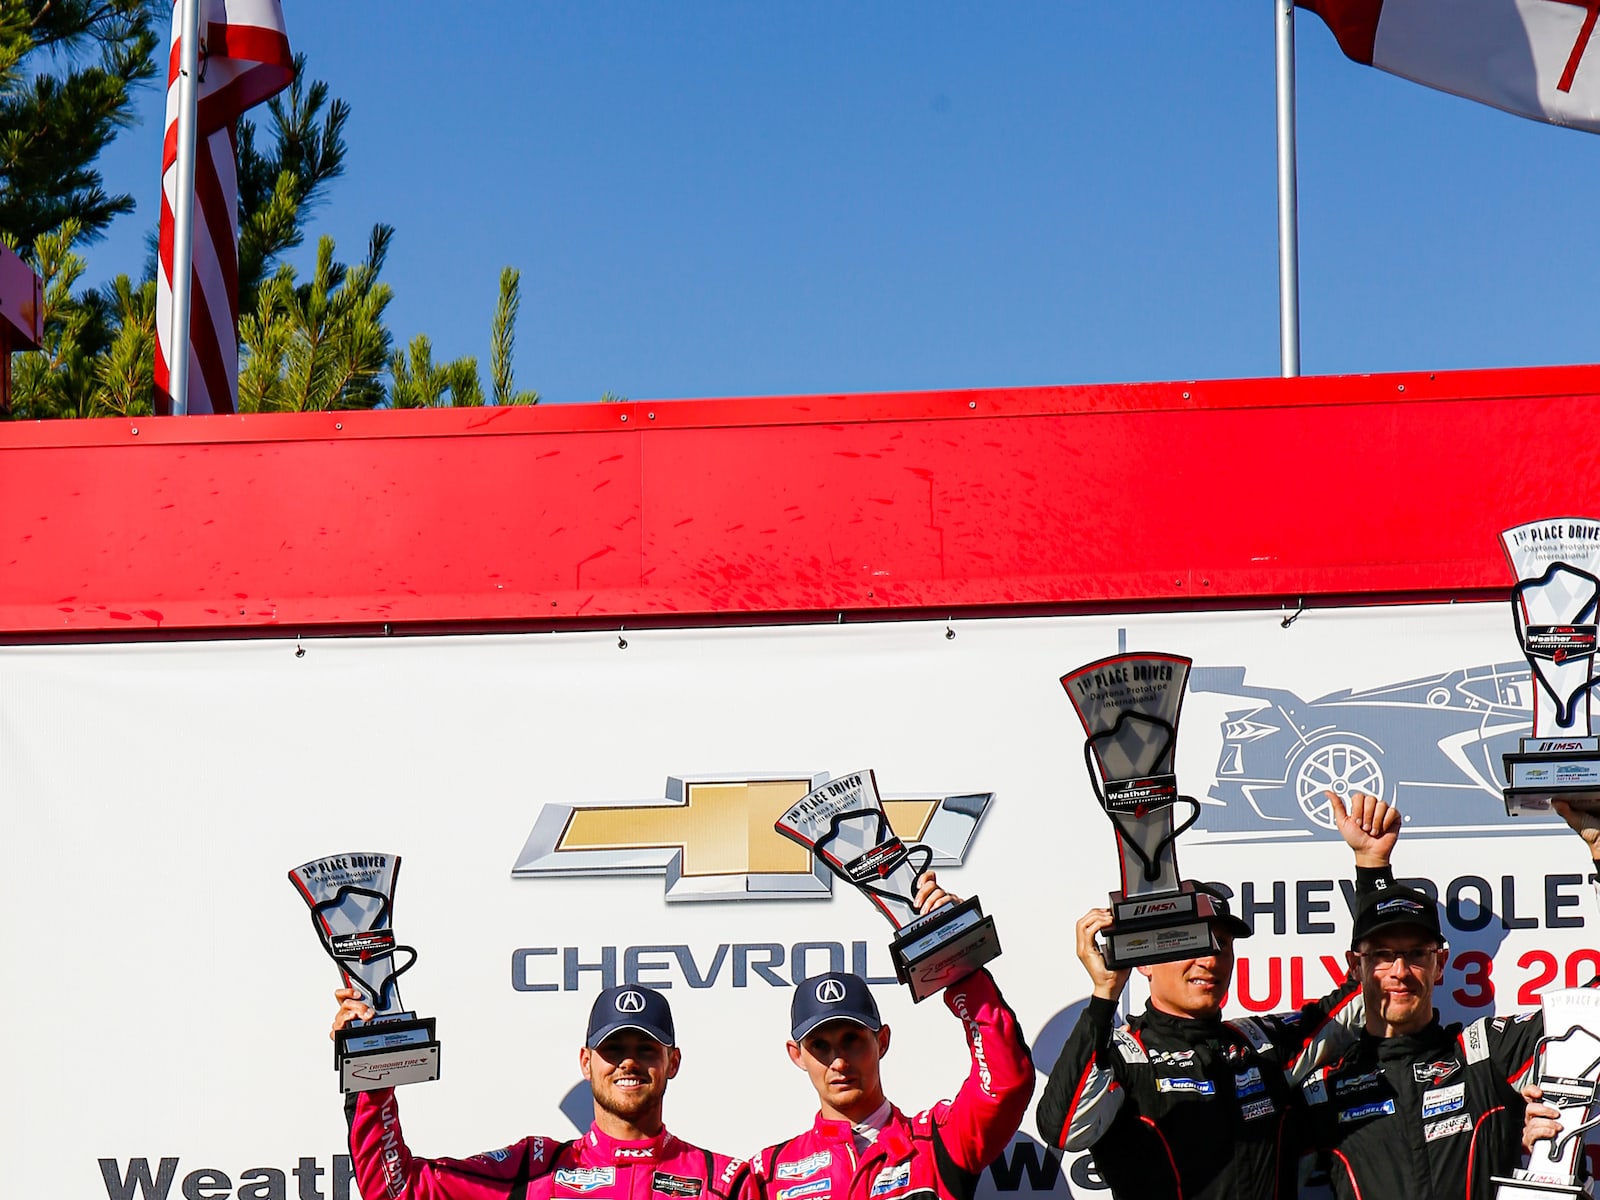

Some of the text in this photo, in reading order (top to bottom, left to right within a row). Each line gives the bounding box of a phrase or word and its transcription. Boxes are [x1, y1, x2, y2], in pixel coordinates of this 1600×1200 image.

[1531, 525, 1563, 541] PLACE
[1095, 669, 1128, 689] PLACE
[1133, 665, 1173, 682] DRIVER
[1090, 683, 1168, 702] Daytona Prototype
[1553, 742, 1583, 750] IMSA
[799, 791, 828, 813] PLACE
[828, 775, 862, 796] DRIVER
[318, 858, 347, 874] PLACE
[352, 856, 386, 868] DRIVER
[1147, 902, 1178, 913] IMSA
[614, 1147, 656, 1158] HRX
[721, 1158, 743, 1184] HRX
